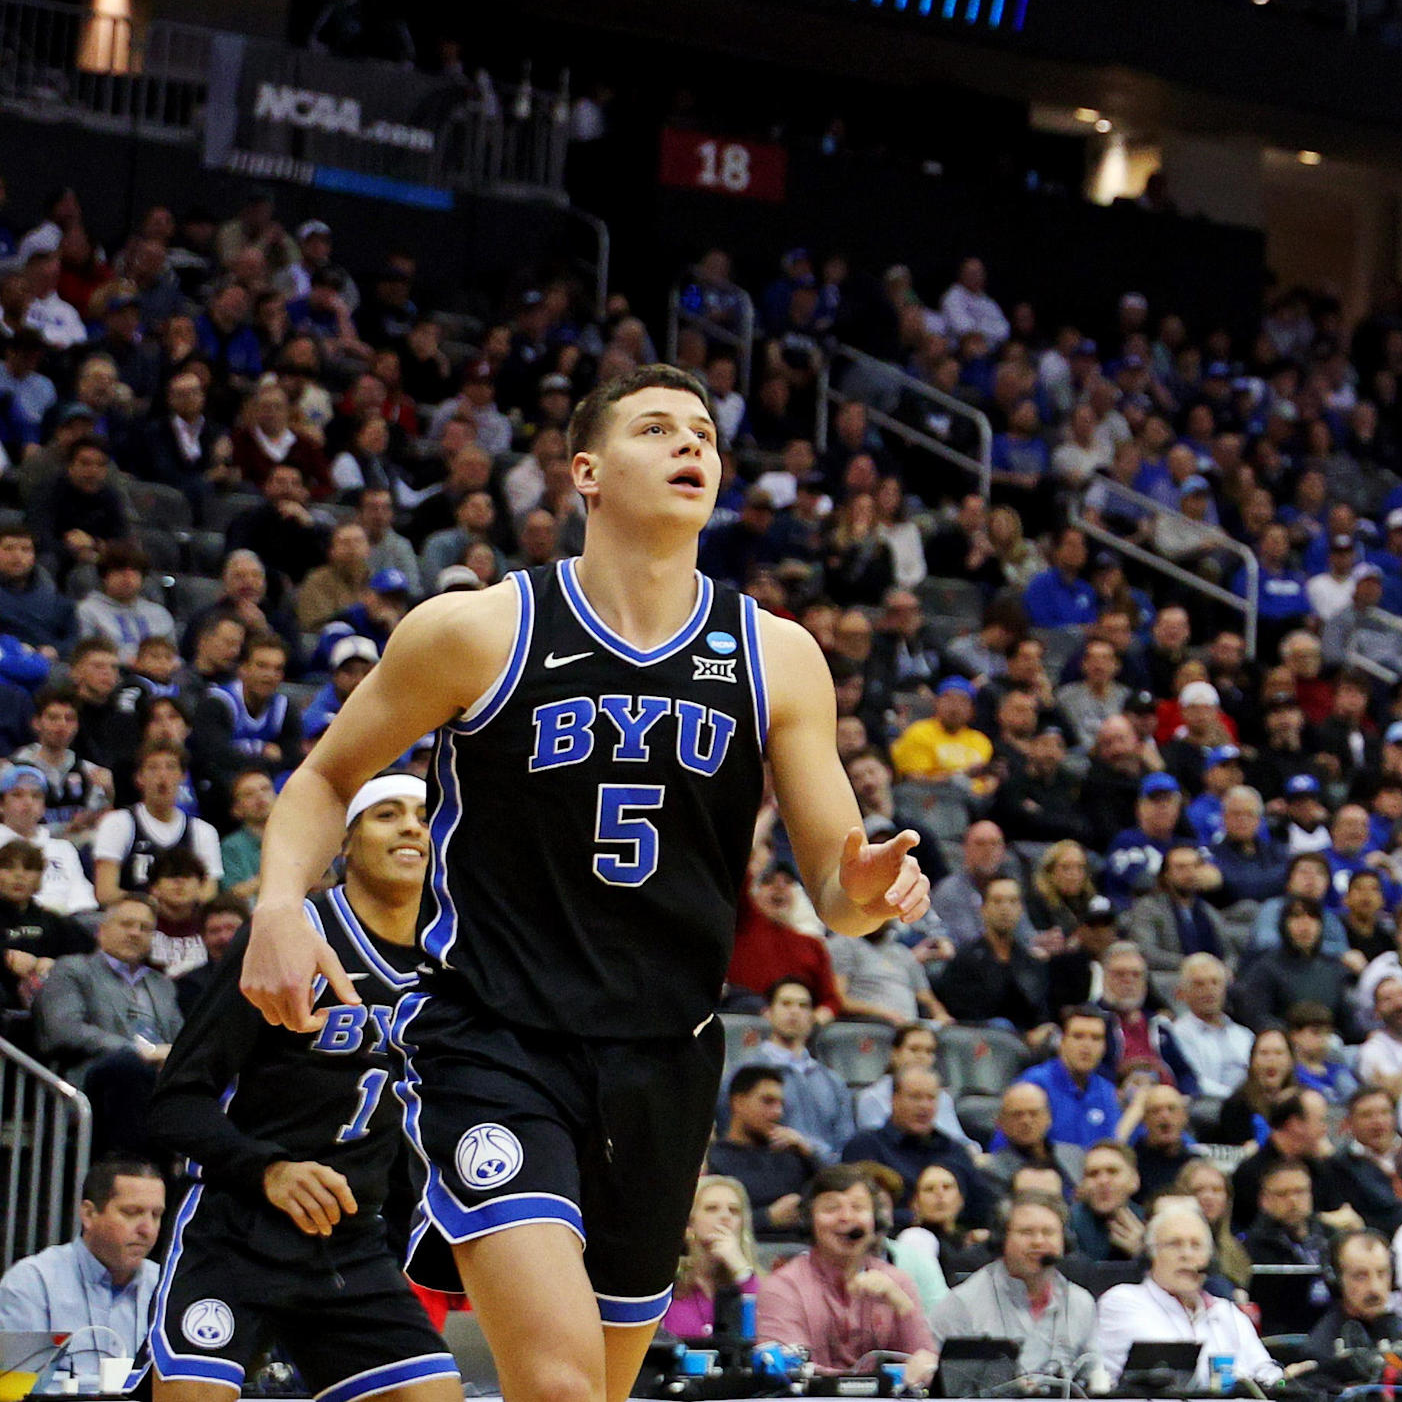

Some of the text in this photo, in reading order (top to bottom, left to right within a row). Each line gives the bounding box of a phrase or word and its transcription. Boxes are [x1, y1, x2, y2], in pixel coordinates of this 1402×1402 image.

[697, 140, 751, 192] 18
[528, 694, 737, 778] BYU
[592, 783, 666, 887] 5
[336, 1068, 389, 1143] 1
